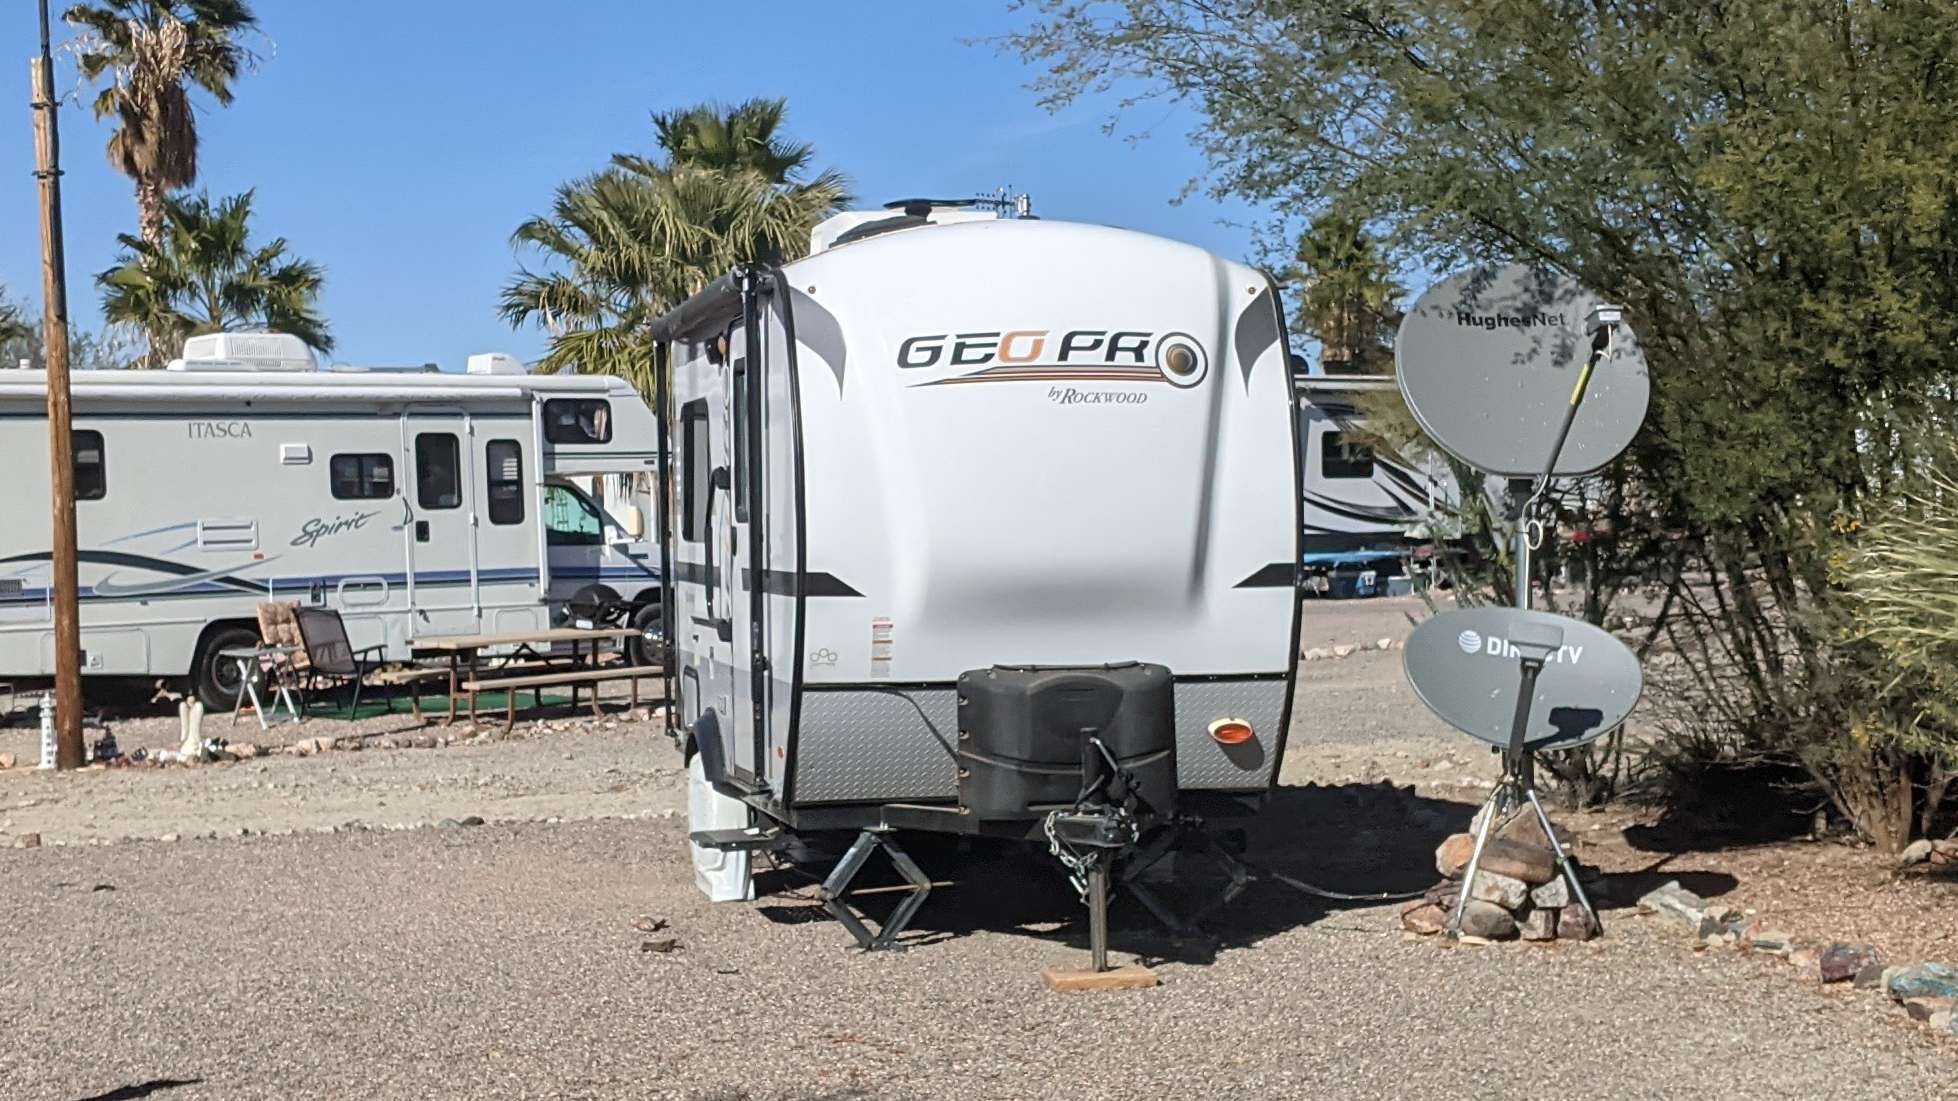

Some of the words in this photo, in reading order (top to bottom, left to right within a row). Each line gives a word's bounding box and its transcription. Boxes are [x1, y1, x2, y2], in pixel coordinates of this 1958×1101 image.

[1457, 312, 1566, 330] HughesNet
[897, 330, 1050, 369] GEO
[1047, 386, 1063, 402] by
[188, 422, 252, 438] ITASCA
[290, 511, 381, 548] Spirit
[1487, 636, 1583, 664] DITV
